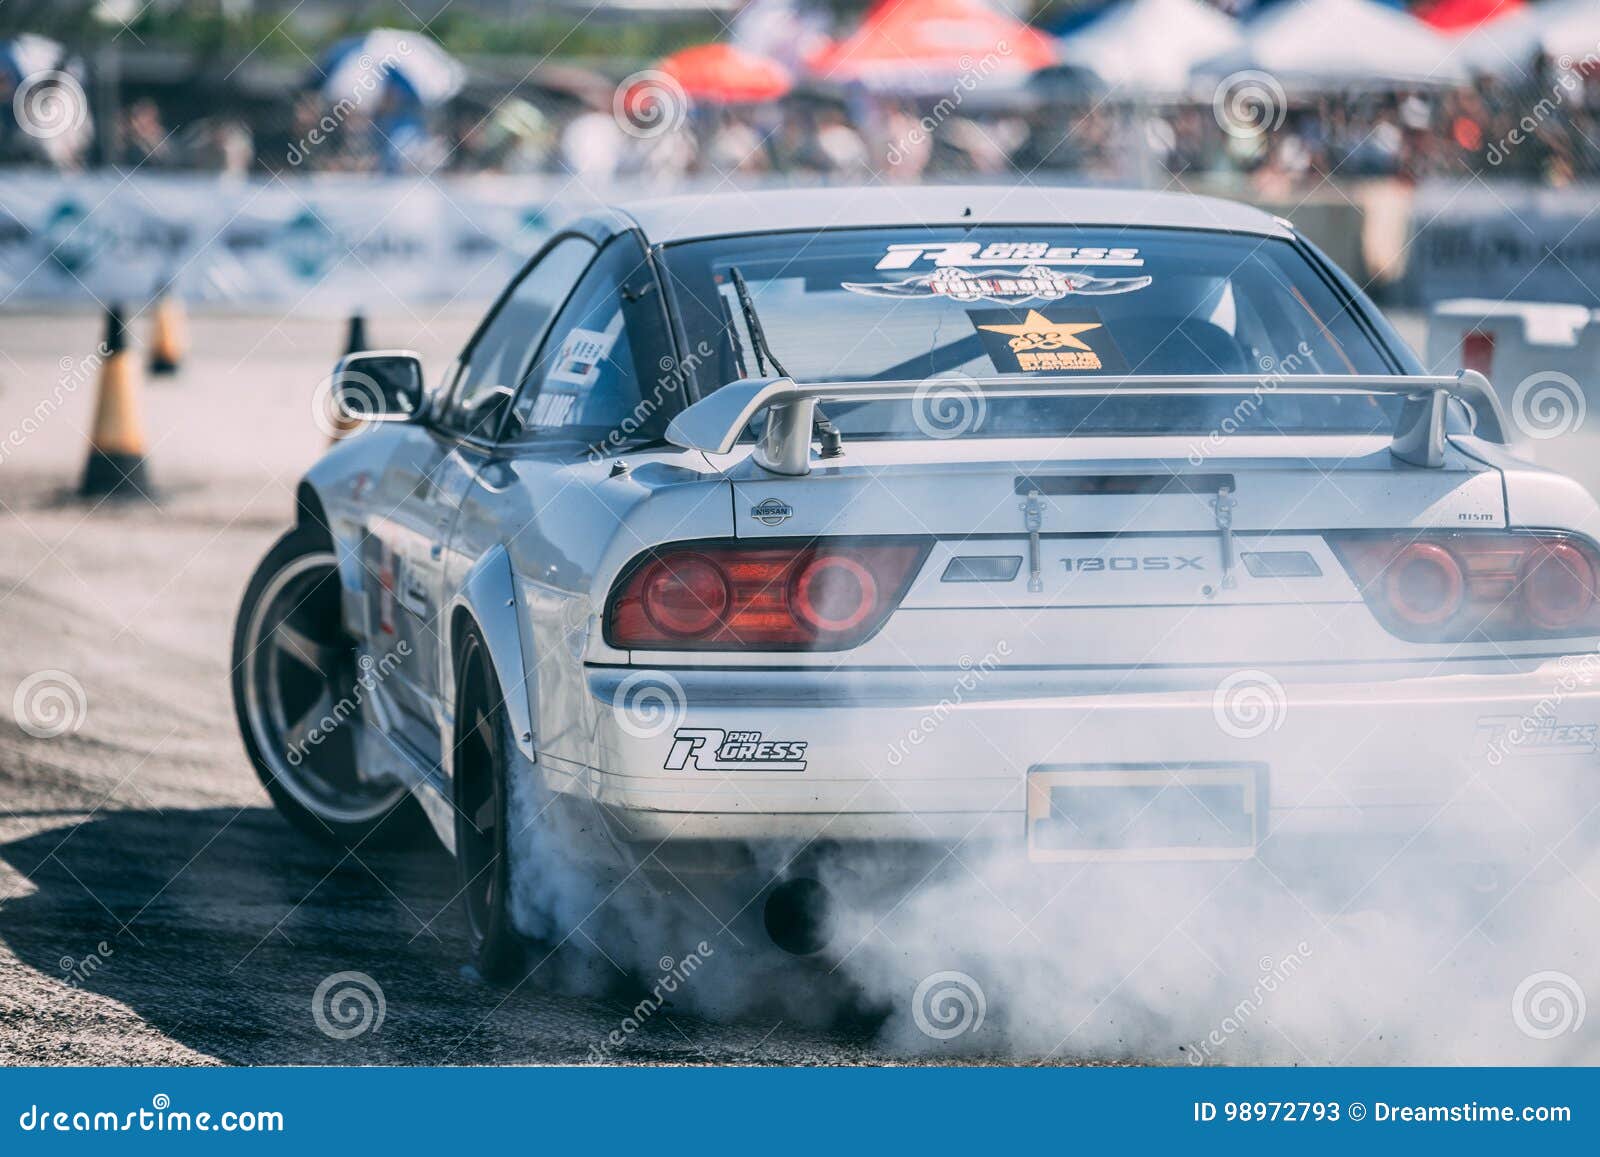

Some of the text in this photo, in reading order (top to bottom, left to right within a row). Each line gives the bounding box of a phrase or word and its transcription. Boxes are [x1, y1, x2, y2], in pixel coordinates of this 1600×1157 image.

[756, 507, 788, 515] NISSAN
[1059, 556, 1204, 572] 180SX
[727, 731, 762, 743] PRO
[719, 742, 808, 760] GRESS
